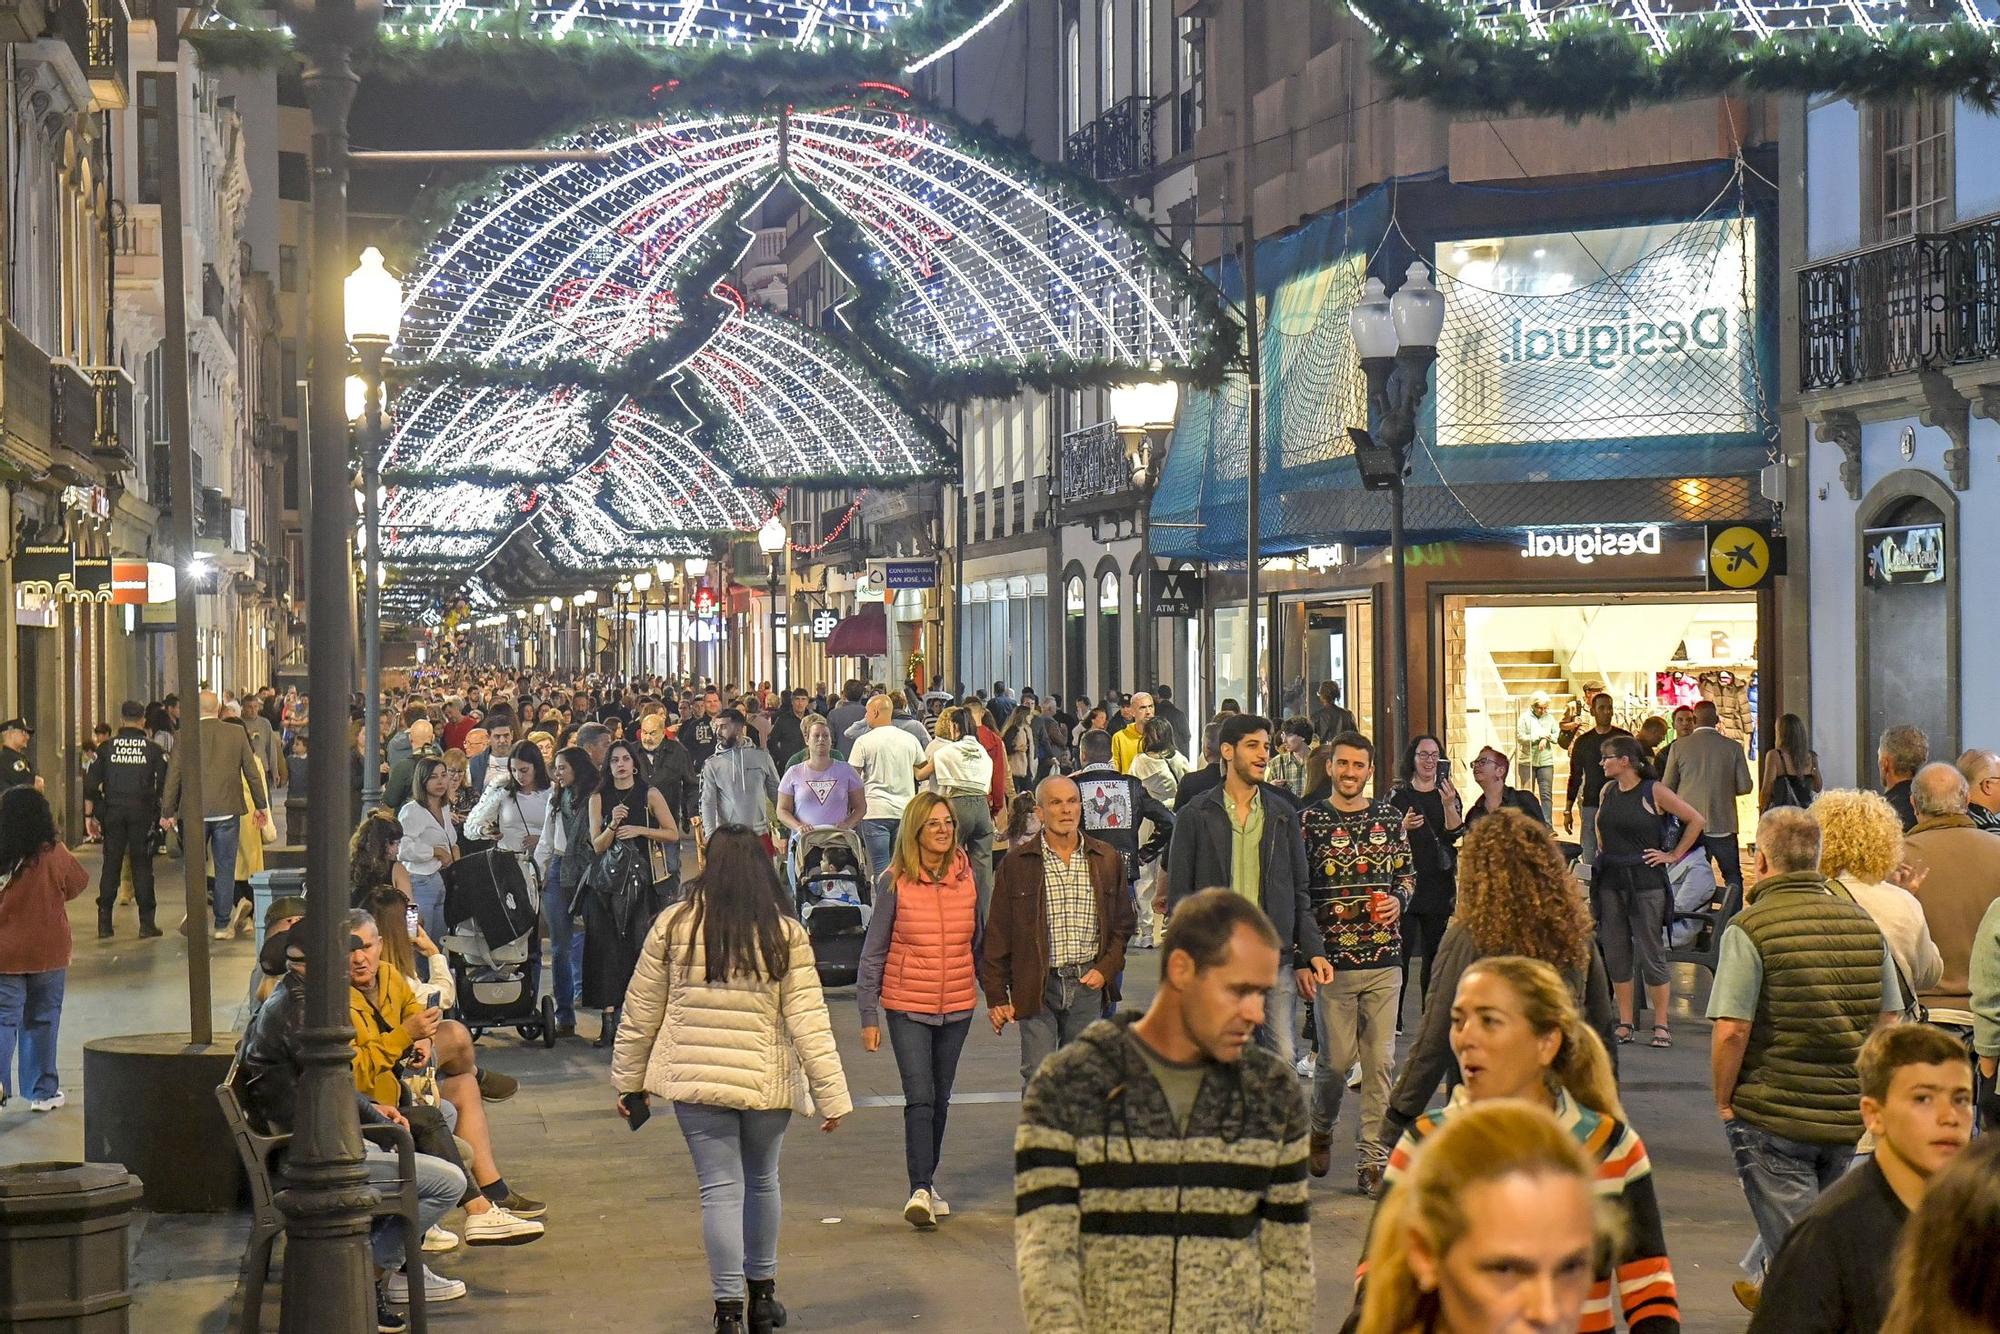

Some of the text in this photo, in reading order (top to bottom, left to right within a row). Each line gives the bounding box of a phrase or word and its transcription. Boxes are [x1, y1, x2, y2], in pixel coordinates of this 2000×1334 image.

[1156, 604, 1175, 612] ATM
[115, 746, 143, 755] LOCAL
[110, 753, 147, 764] CANARIA
